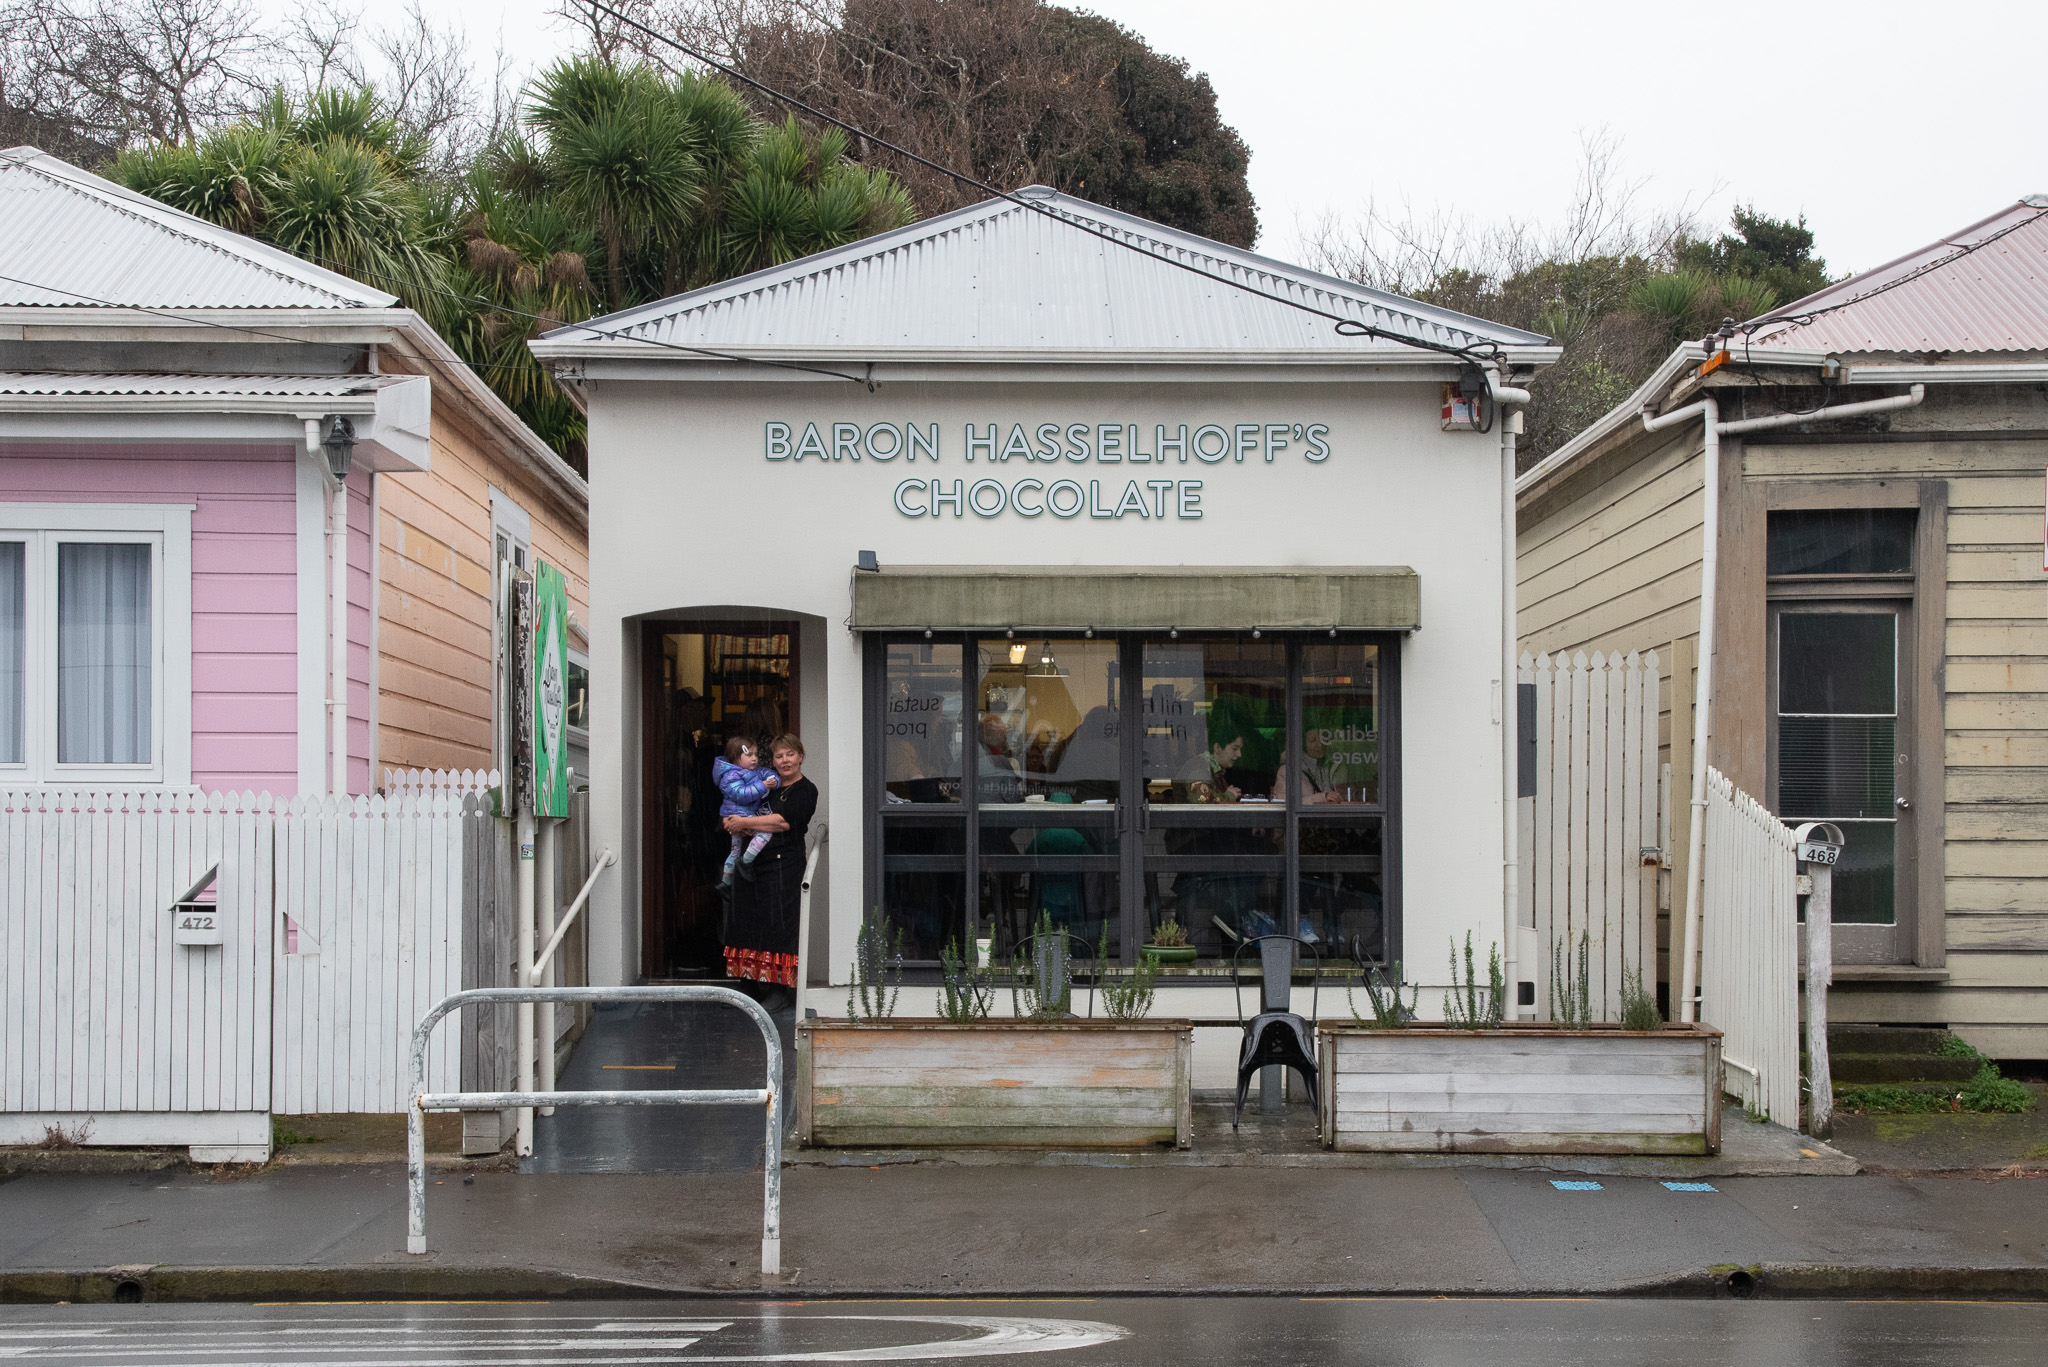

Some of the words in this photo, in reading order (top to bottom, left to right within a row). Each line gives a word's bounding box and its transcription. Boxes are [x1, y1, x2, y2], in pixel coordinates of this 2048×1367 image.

[765, 421, 939, 462] BARON
[965, 422, 1331, 464] HASSELHOFF'S
[894, 477, 1204, 519] CHOCOLATE
[1806, 849, 1837, 864] 468
[182, 917, 214, 930] 472
